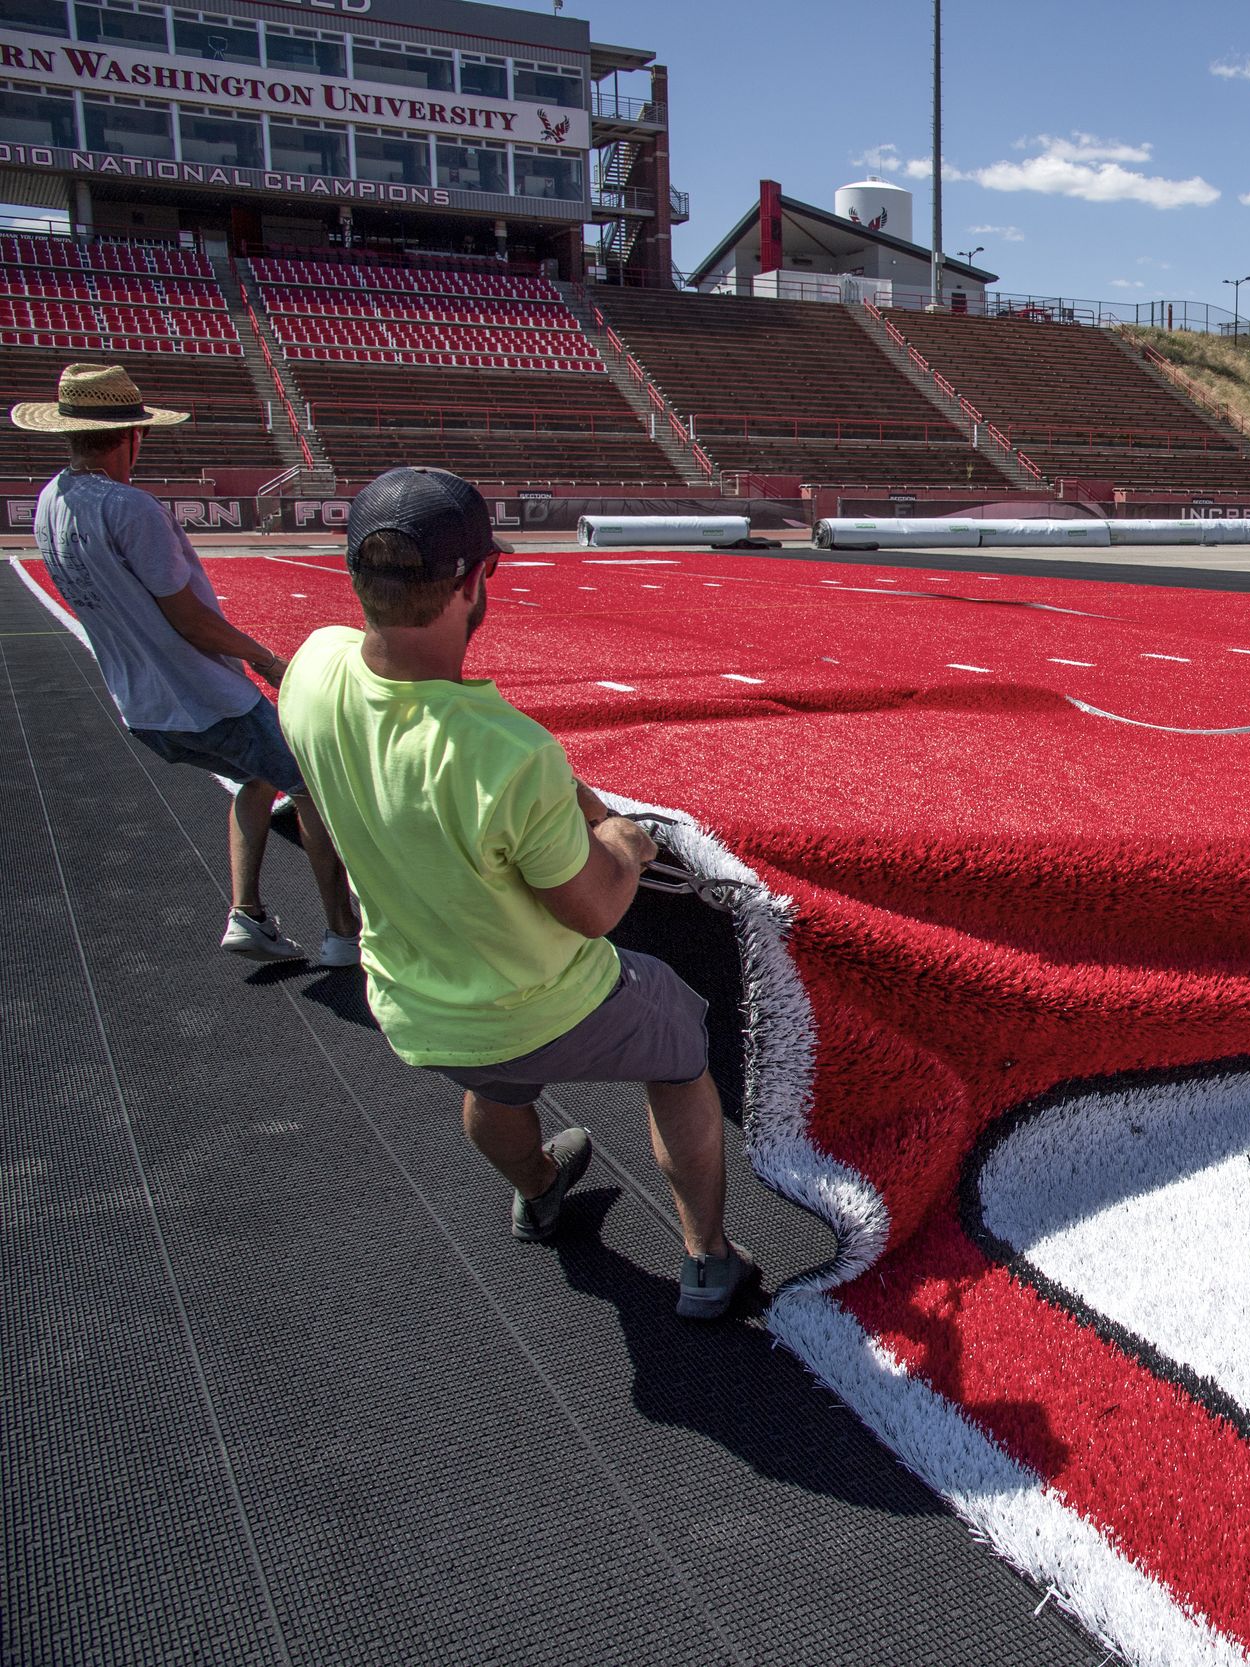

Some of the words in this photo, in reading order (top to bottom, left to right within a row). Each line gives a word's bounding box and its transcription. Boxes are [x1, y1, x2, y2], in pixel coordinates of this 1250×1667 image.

[61, 46, 314, 107] WASHINGTON
[320, 83, 519, 132] UNIVERSITY
[71, 151, 251, 187] NATIONAL
[264, 173, 450, 206] CHAMPIONS
